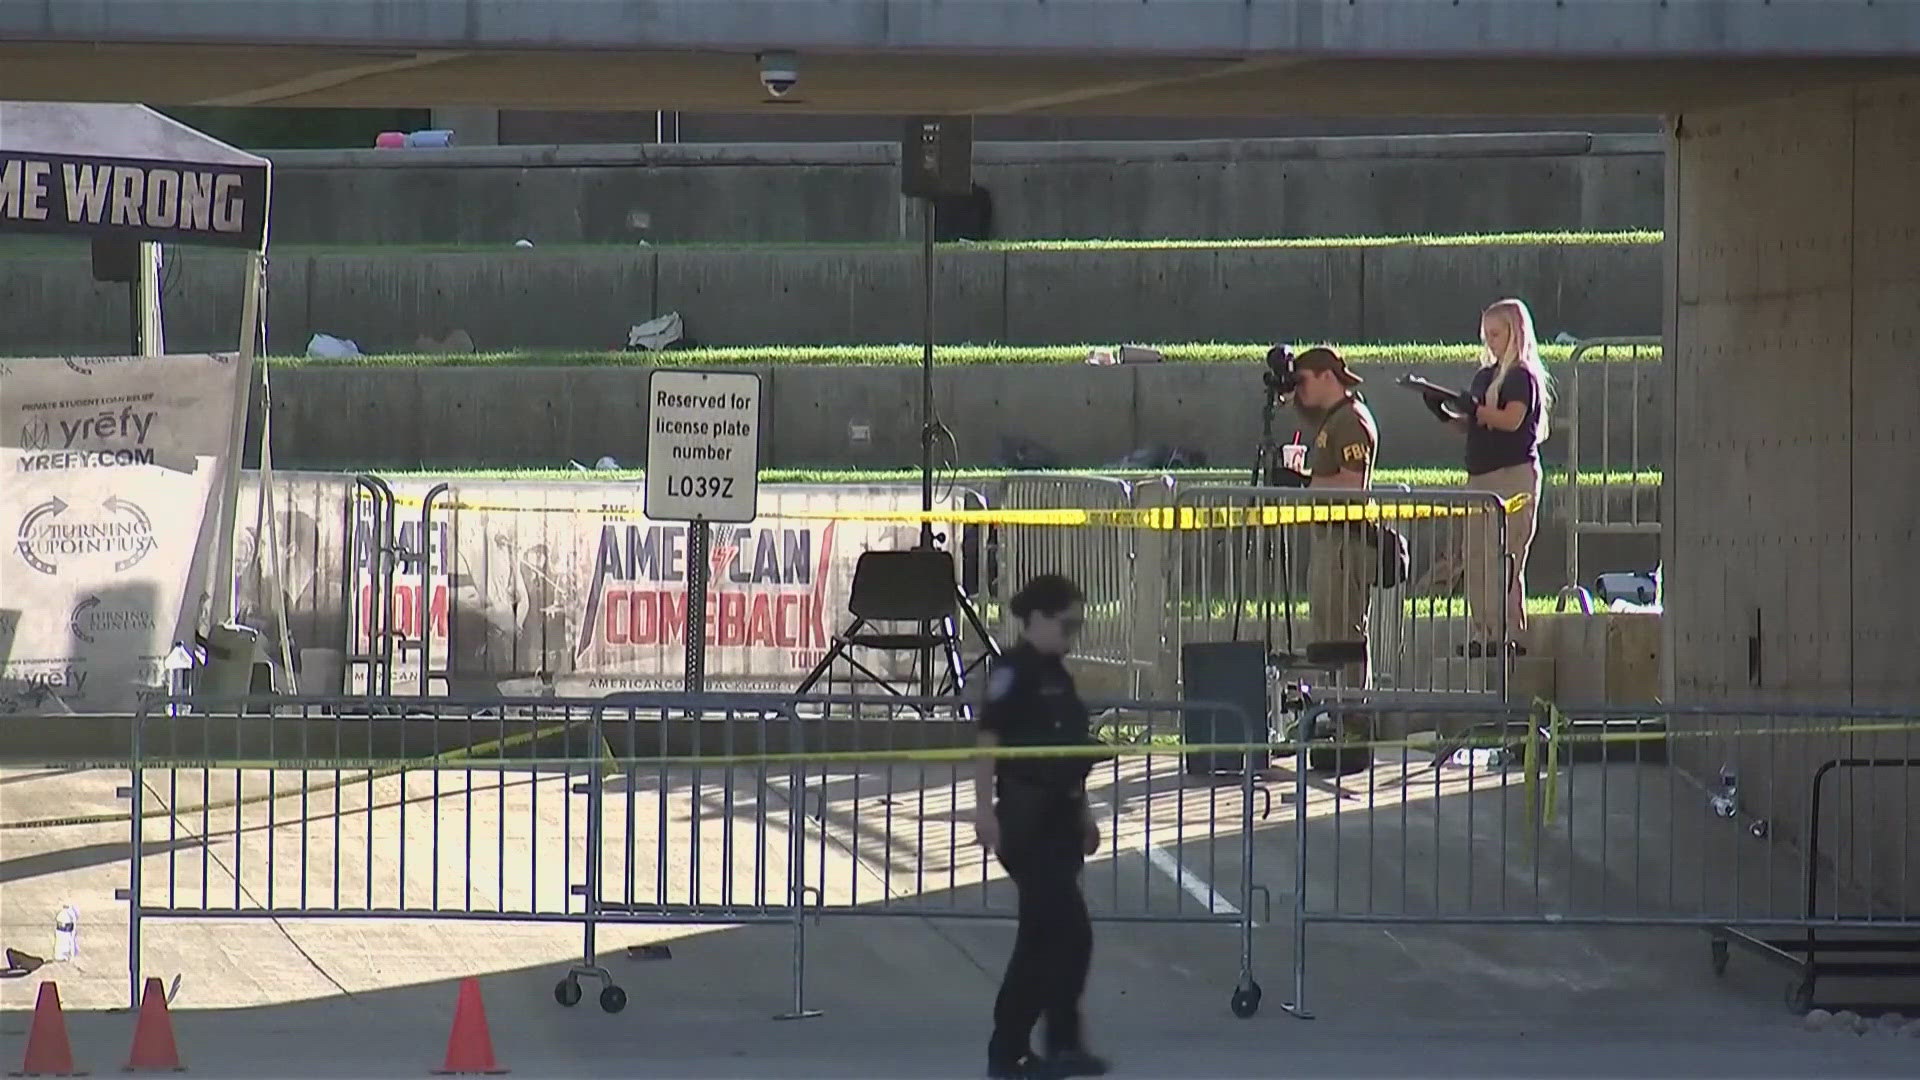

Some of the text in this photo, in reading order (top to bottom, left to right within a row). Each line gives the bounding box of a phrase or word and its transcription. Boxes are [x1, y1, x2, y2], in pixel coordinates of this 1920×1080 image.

[62, 163, 244, 232] WRONG
[22, 402, 56, 411] PRIVATE
[59, 398, 99, 408] STUDENT
[101, 396, 125, 405] LOAN
[657, 391, 751, 410] Reserved for
[656, 417, 750, 439] license plate
[19, 448, 155, 472] YREFY.COM
[673, 444, 732, 460] number
[598, 525, 811, 584] AMEICAN
